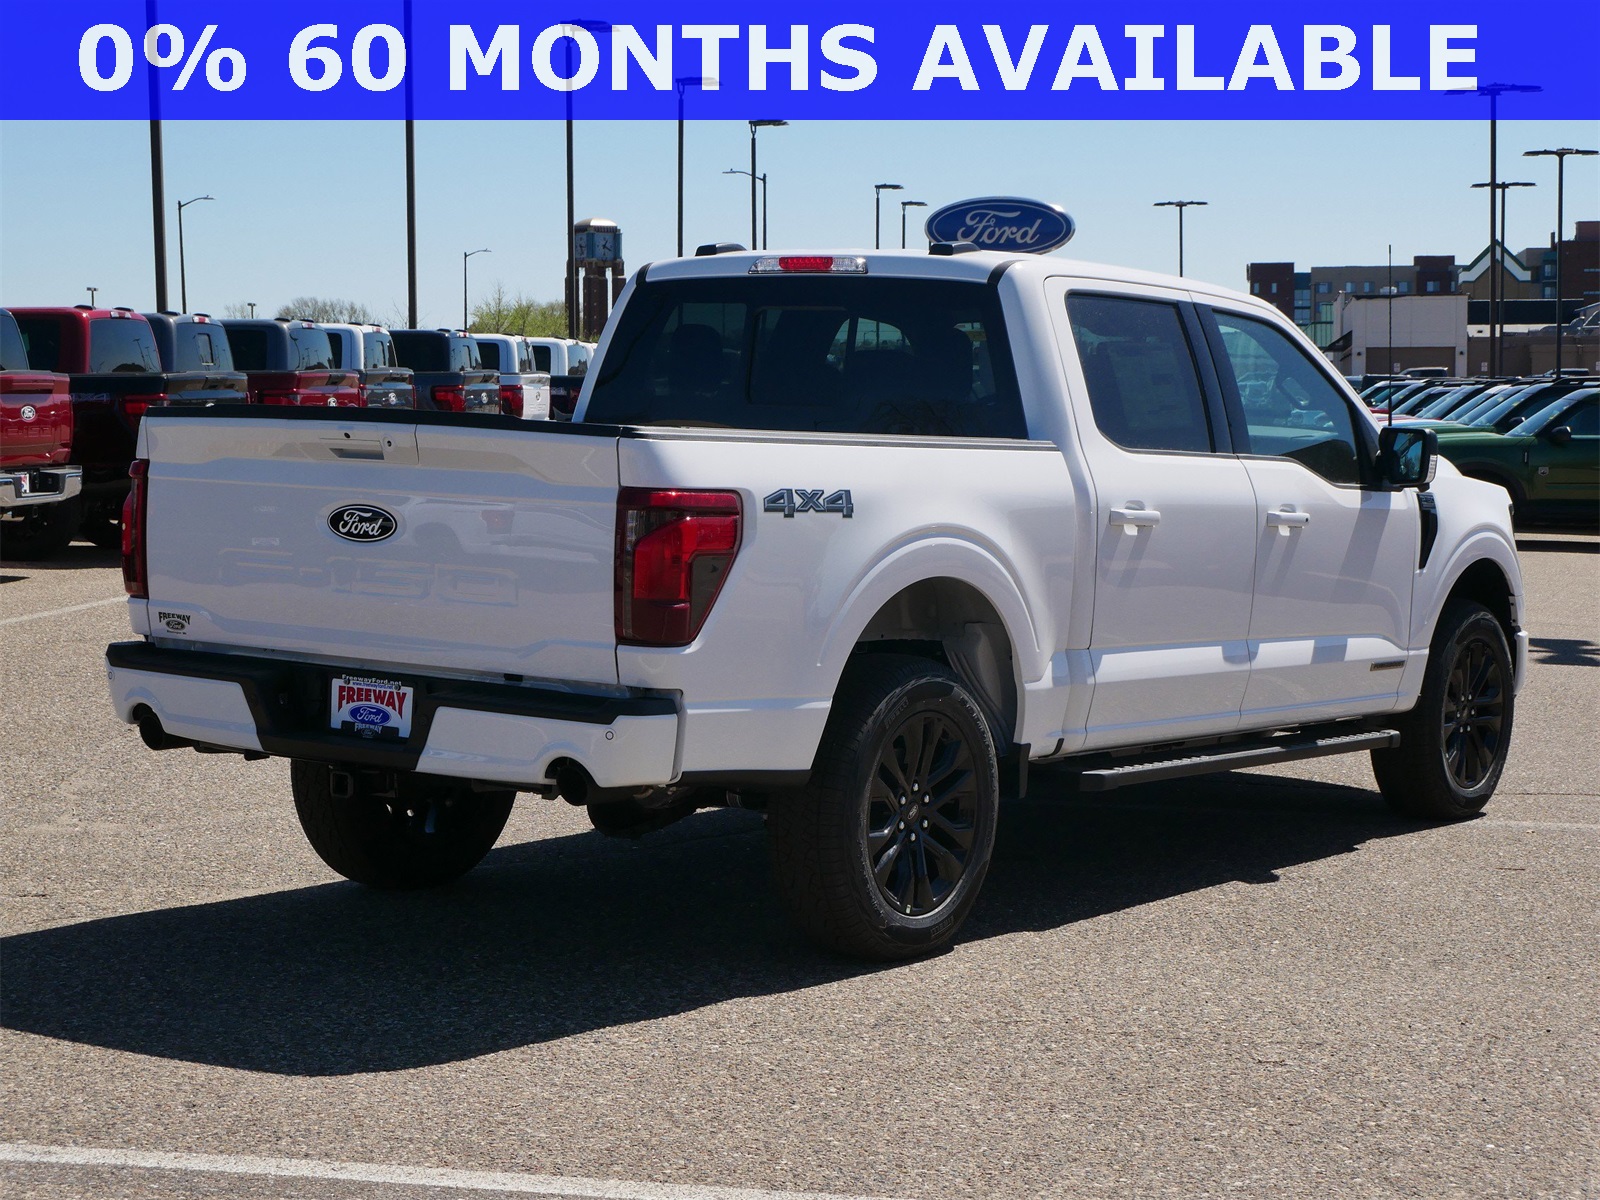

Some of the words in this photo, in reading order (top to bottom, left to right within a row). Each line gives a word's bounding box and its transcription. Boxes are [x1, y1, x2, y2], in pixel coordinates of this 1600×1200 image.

[957, 210, 1042, 244] Ford
[339, 510, 383, 537] Ford
[158, 612, 190, 625] FREEWAY
[342, 674, 402, 686] FreewayFord.net
[338, 685, 407, 720] FREEWAY
[357, 706, 383, 723] Ford
[355, 723, 382, 734] FREEWAY
